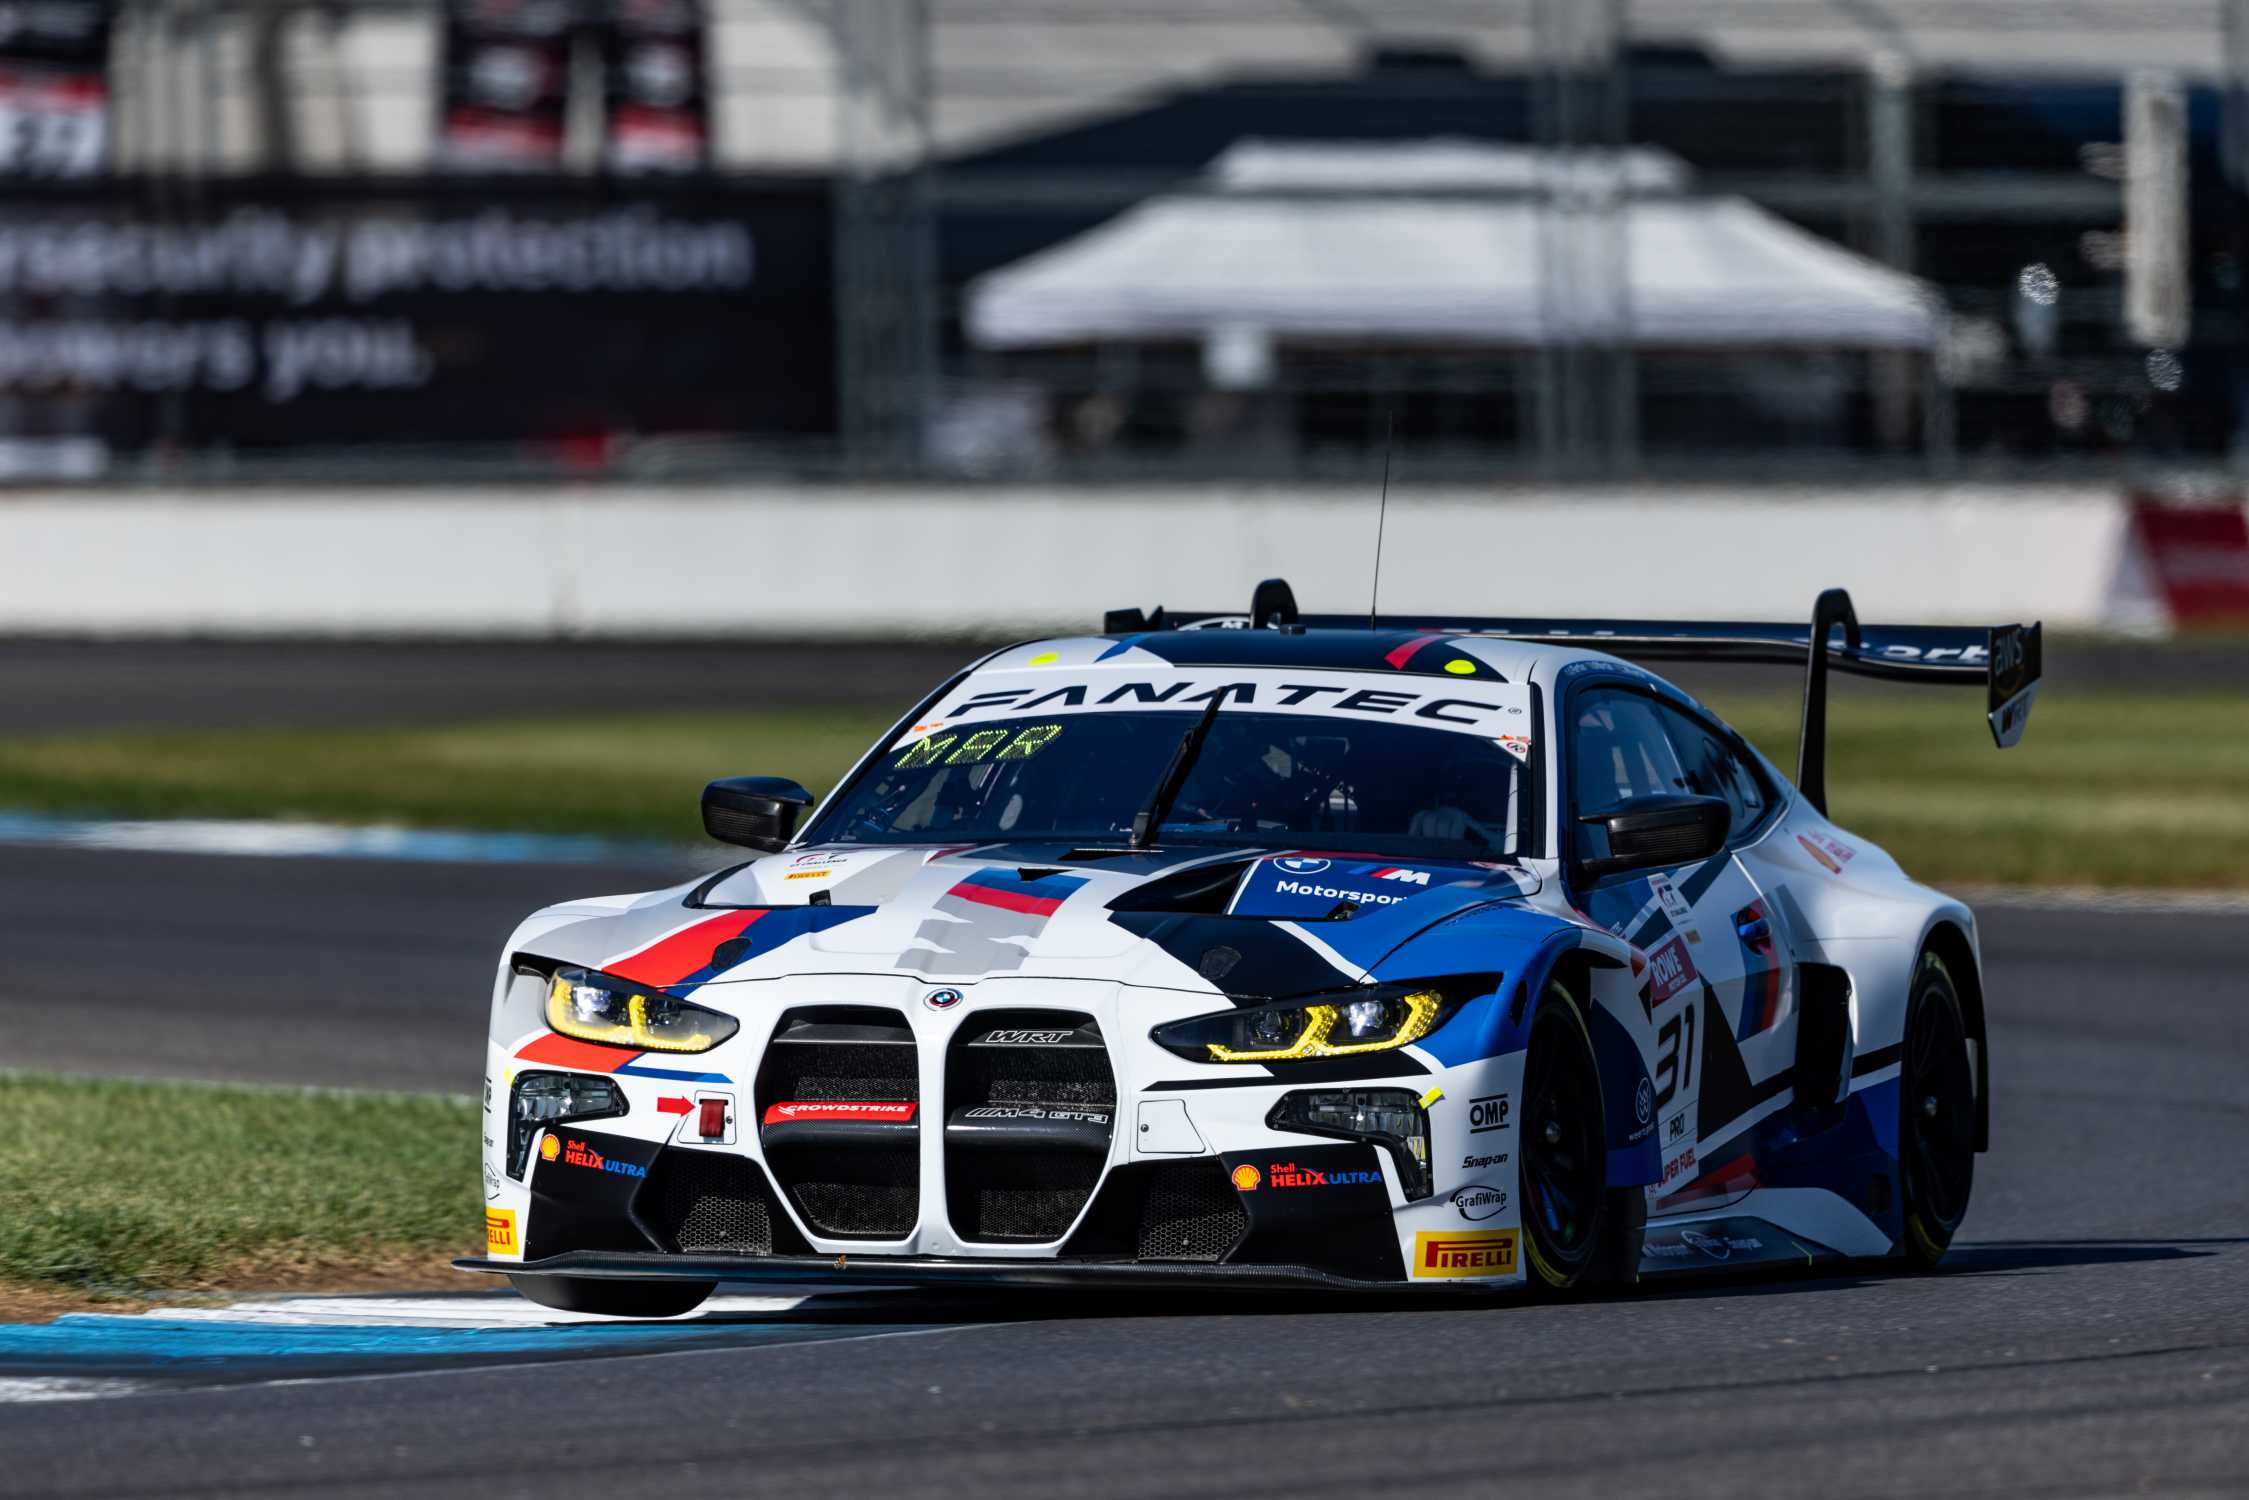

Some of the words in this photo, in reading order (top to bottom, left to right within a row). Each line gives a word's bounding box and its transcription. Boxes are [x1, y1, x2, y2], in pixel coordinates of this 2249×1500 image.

[345, 206, 756, 304] protection
[945, 682, 1502, 726] FANATEC
[895, 724, 1062, 768] MAR
[1275, 880, 1407, 906] Motorspor
[985, 1030, 1074, 1043] WRT
[1656, 1002, 1695, 1109] 31
[786, 1104, 909, 1113] CROWDSTRIKE
[1469, 1100, 1510, 1127] OMP
[1669, 1113, 1686, 1141] PRO
[567, 1139, 587, 1152] Shell
[565, 1149, 605, 1170] HELIX
[605, 1158, 647, 1178] ULTRA
[1270, 1162, 1296, 1175] Shell
[1462, 1152, 1509, 1169] Snap-on
[1271, 1171, 1327, 1188] HELIX
[1328, 1170, 1382, 1185] ULTRA
[1456, 1191, 1507, 1208] GrafiWrap
[1425, 1238, 1513, 1268] PIRELLI
